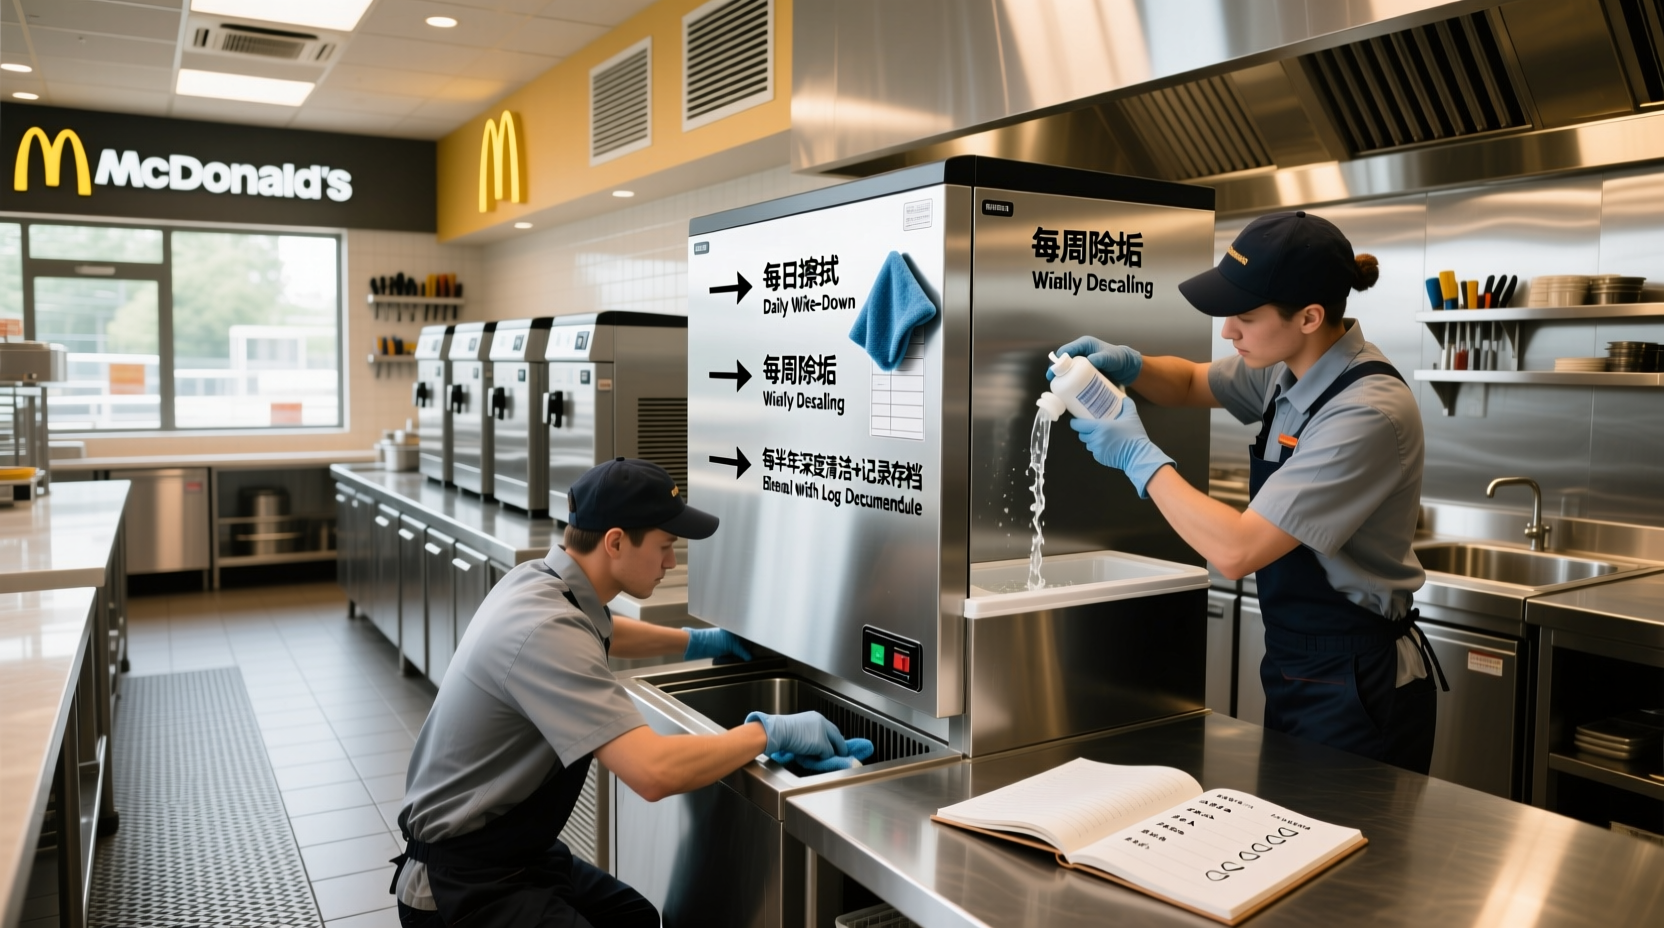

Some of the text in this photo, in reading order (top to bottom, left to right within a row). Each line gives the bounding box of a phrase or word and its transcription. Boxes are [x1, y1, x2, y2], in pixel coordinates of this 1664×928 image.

[94, 149, 353, 202] McDonald's
[1031, 226, 1144, 268] 每周除垢
[763, 297, 789, 318] Daily
[763, 353, 837, 385] 每周除垢
[821, 484, 842, 507] Log
